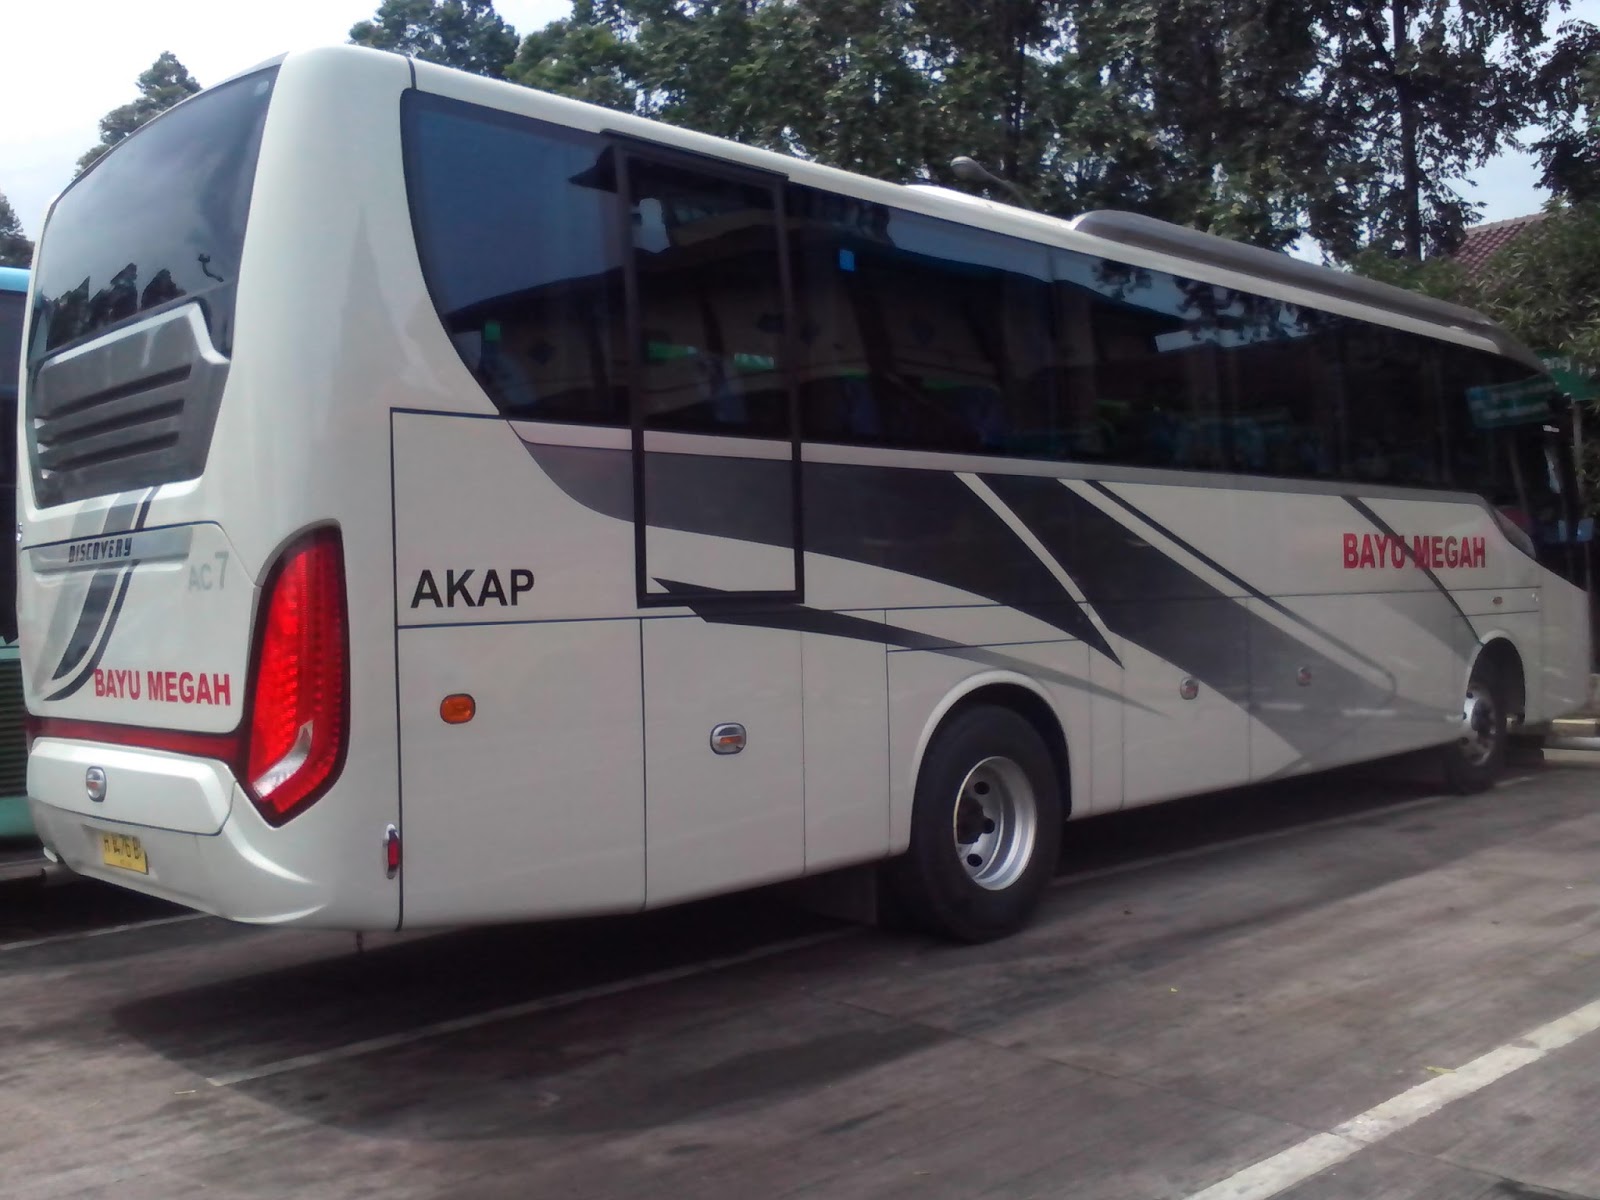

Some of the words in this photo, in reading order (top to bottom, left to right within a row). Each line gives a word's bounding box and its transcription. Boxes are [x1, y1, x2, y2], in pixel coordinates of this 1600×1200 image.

[68, 537, 133, 563] DISCOVERY
[1343, 533, 1405, 569] BAYU
[1413, 535, 1486, 569] MEGAH
[410, 569, 535, 608] AKAP
[94, 668, 141, 700] BAYU
[147, 671, 231, 706] MEGAH
